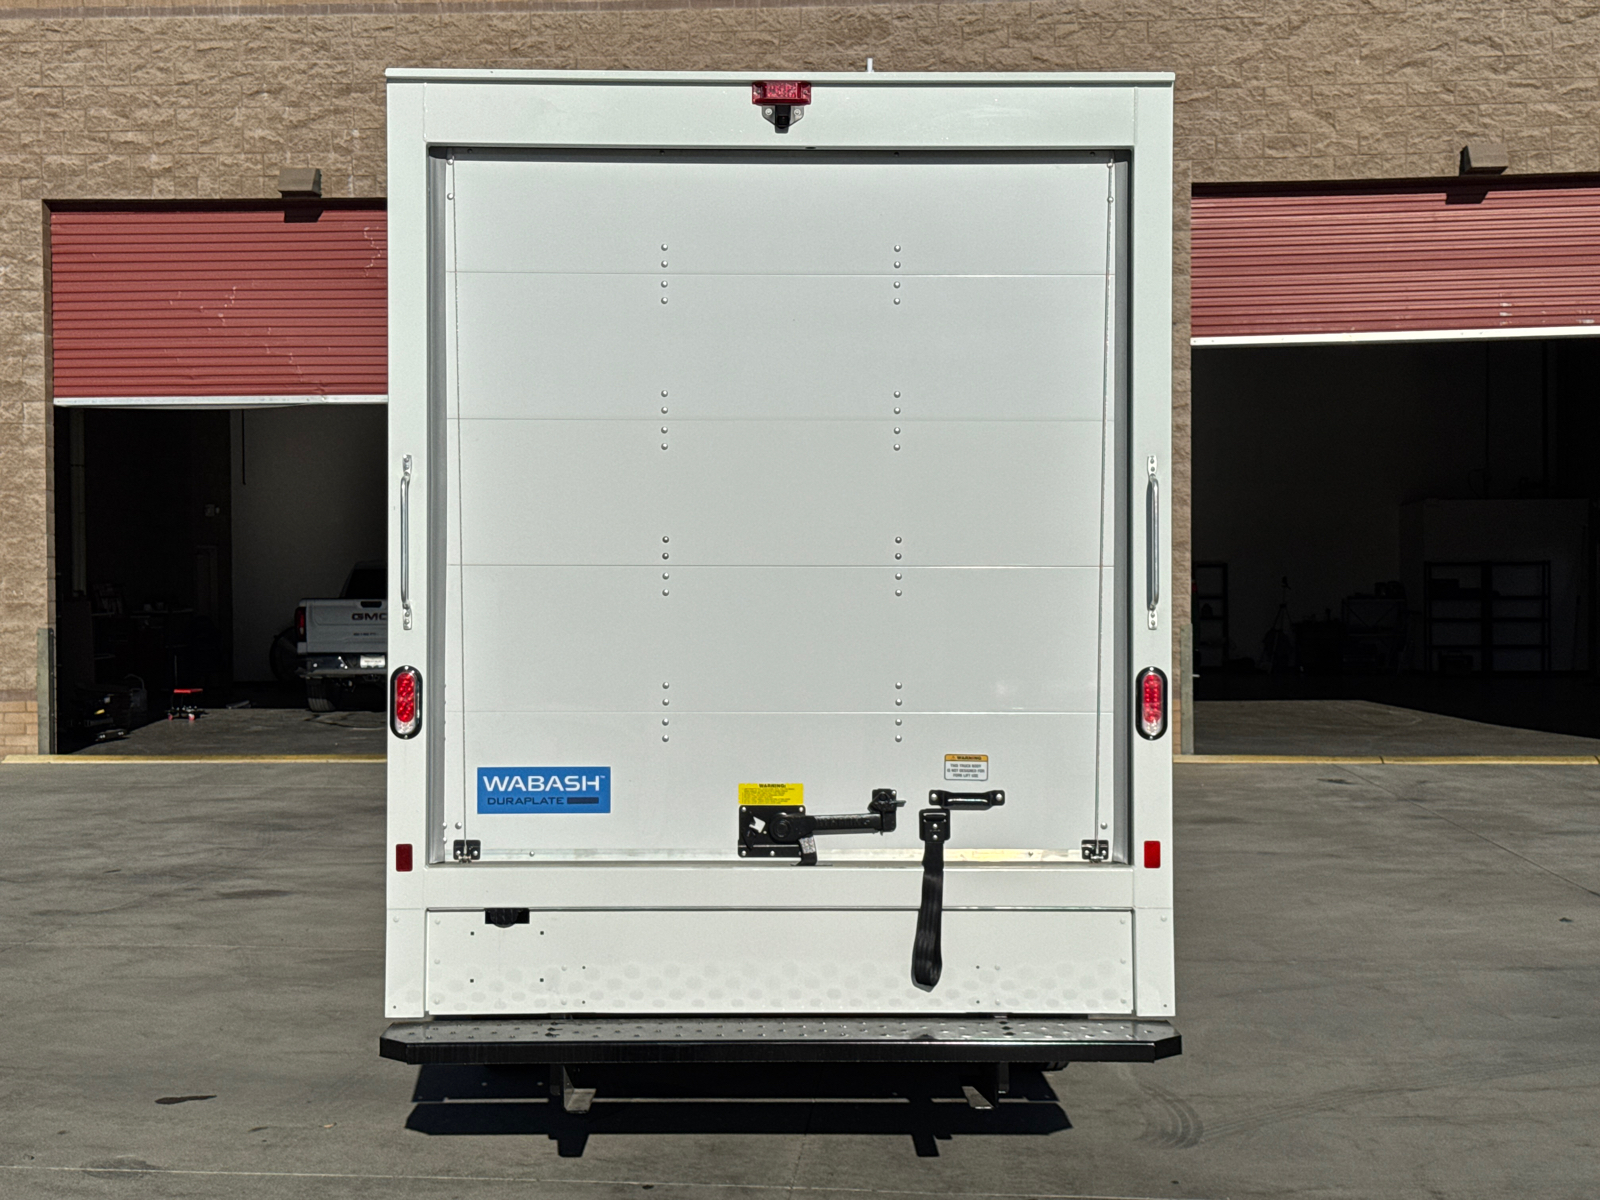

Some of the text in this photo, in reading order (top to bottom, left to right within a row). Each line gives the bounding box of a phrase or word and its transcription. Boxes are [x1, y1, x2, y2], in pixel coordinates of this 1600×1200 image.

[351, 612, 388, 620] GMC
[482, 776, 600, 792] WABASH
[487, 796, 564, 805] DURAPLATE
